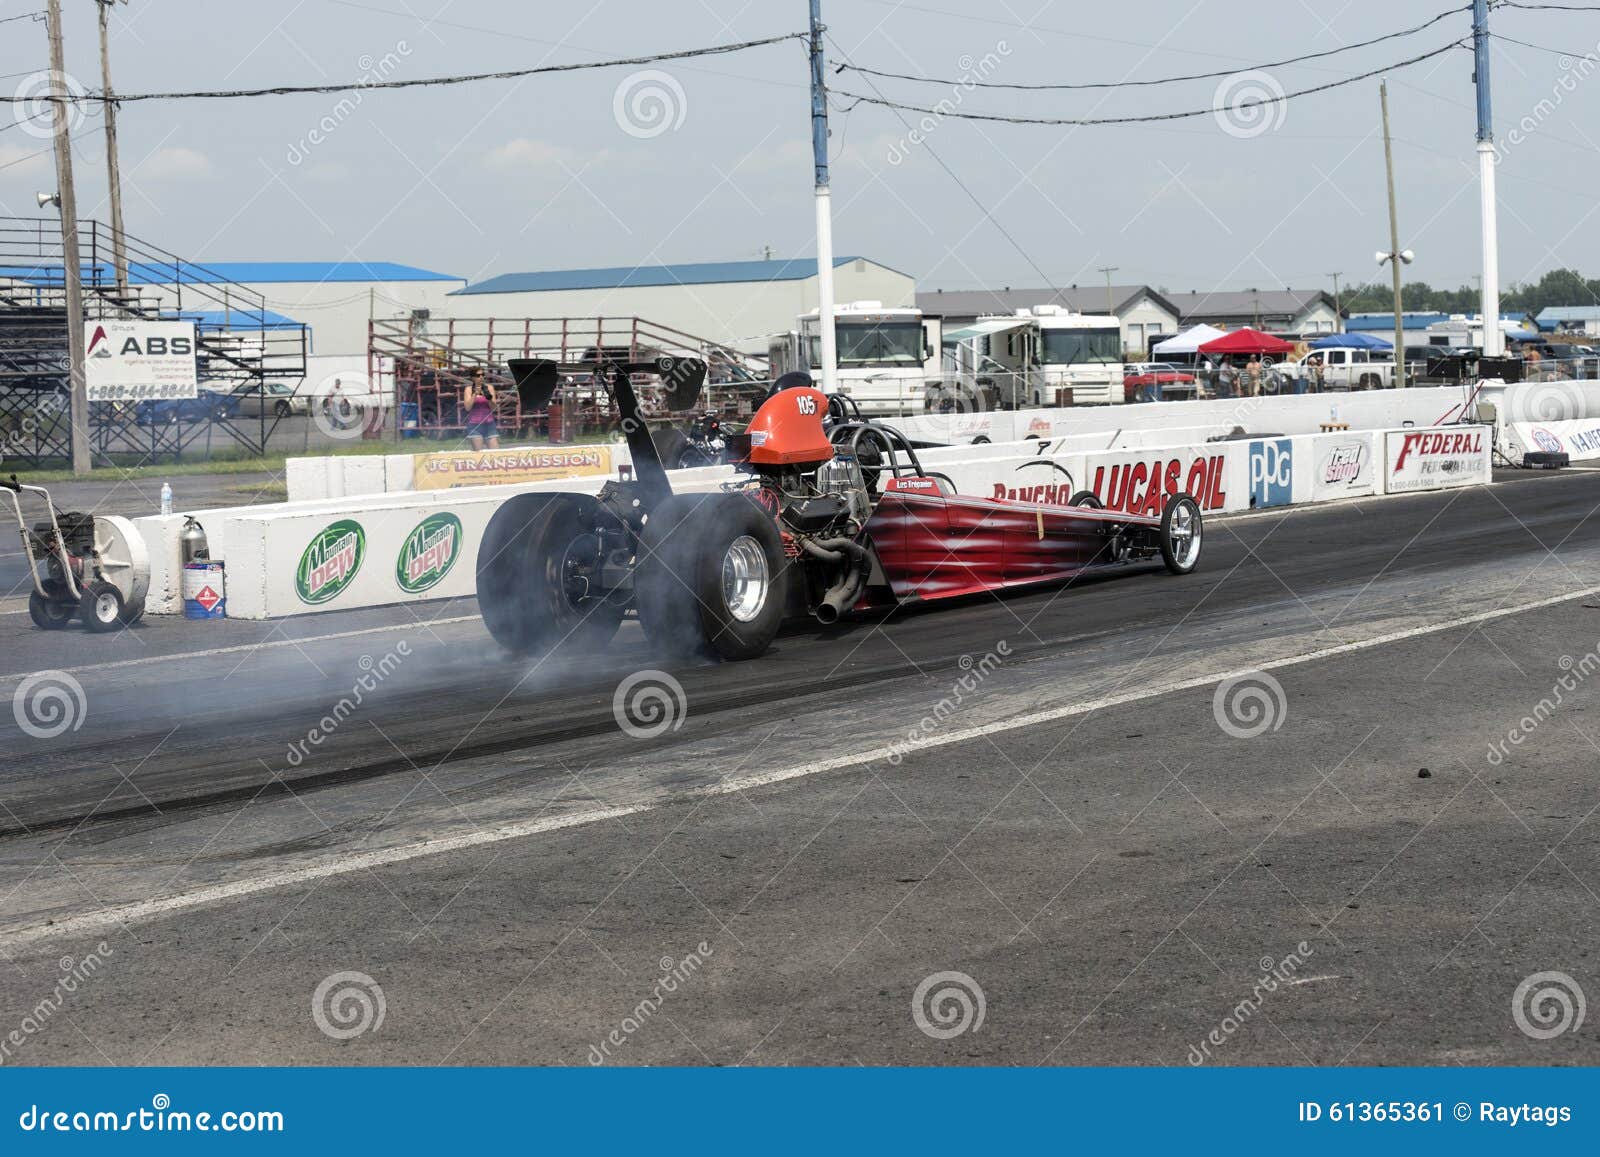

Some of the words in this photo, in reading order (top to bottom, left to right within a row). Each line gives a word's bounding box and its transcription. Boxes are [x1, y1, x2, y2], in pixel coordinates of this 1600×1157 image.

[120, 337, 191, 355] ABS
[427, 458, 449, 473] JC
[454, 452, 601, 473] TRANSMISSION
[1394, 433, 1482, 473] FEDERAL
[993, 483, 1070, 506] RANCHO
[1093, 458, 1181, 516] LUCAS
[1186, 455, 1225, 511] OIL
[307, 533, 353, 581] Mountain
[409, 525, 451, 571] Mountain
